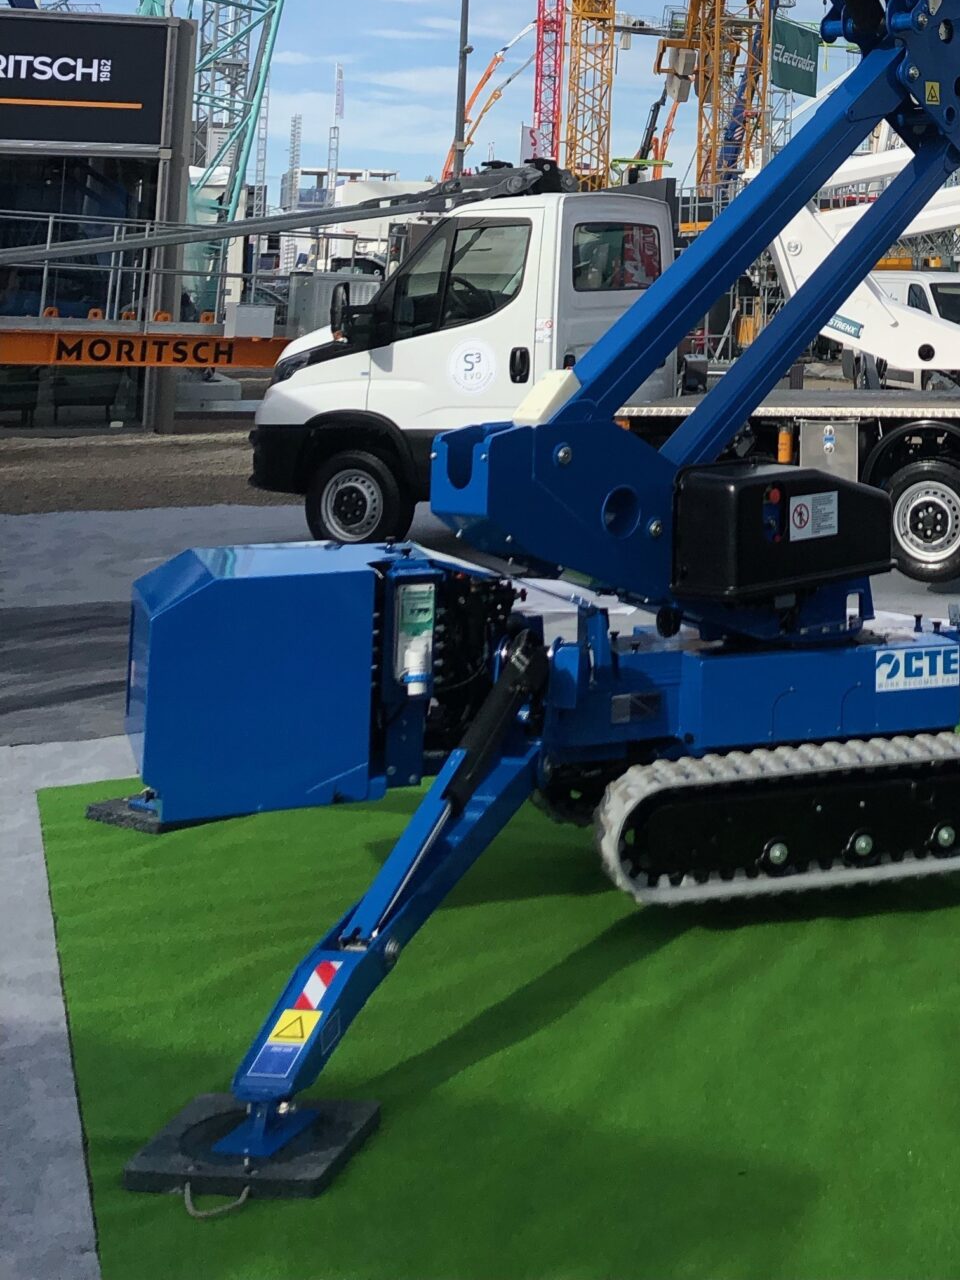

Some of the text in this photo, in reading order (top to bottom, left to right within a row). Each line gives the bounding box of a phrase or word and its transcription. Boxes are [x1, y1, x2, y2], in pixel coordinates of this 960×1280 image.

[100, 59, 112, 82] 1962
[828, 319, 857, 335] STRENX
[55, 338, 234, 364] MORITSCH
[904, 649, 959, 678] CTE
